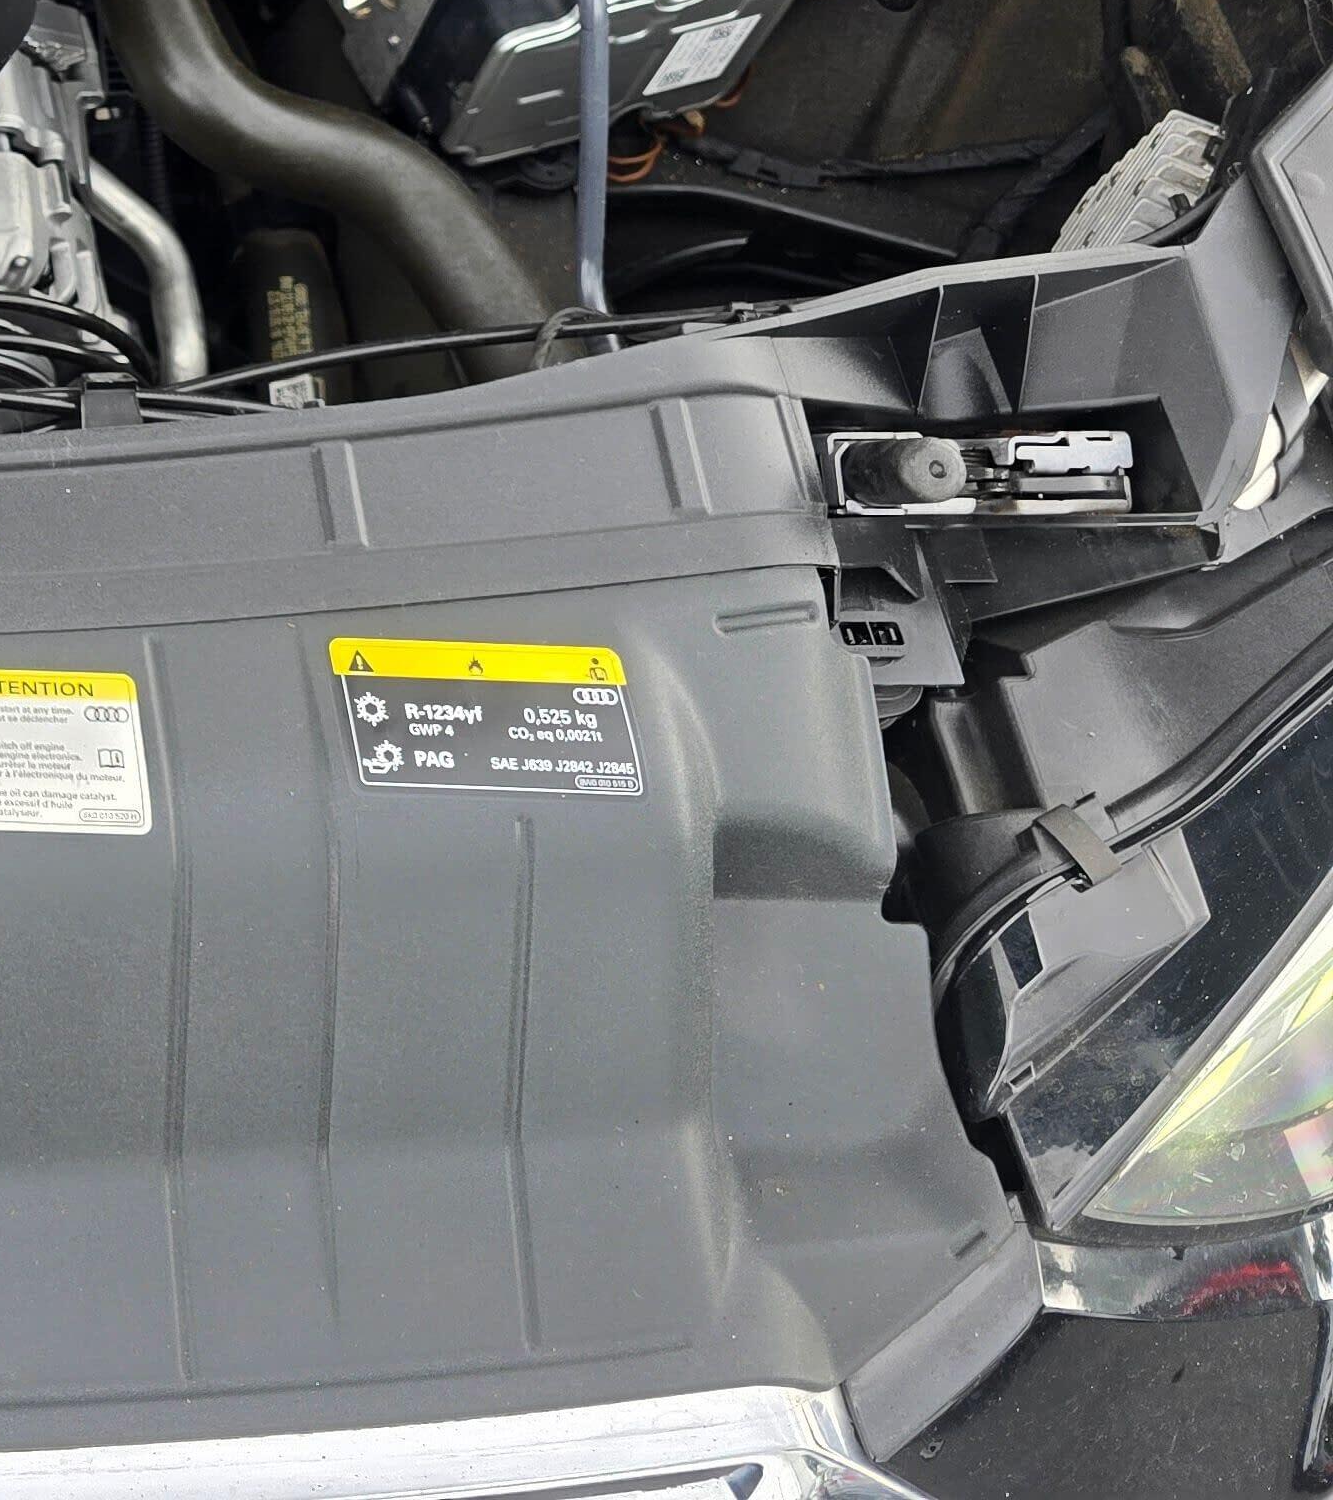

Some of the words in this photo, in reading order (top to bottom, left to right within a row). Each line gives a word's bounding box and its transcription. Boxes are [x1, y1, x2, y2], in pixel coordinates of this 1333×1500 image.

[0, 706, 20, 714] start
[33, 708, 49, 717] any
[405, 703, 483, 725] R-1234yf
[523, 707, 572, 727] 0,525
[575, 709, 598, 729] kg
[409, 723, 442, 737] GWP
[444, 725, 455, 737] 4
[537, 730, 555, 743] eq
[20, 742, 33, 750] off
[34, 743, 65, 752] engine
[0, 752, 30, 761] engine
[414, 750, 455, 769] PAG
[38, 762, 71, 770] moteur
[490, 757, 519, 771] SAE
[521, 758, 553, 772] J639
[555, 760, 594, 774] J2842
[596, 761, 635, 776] J2845
[76, 773, 88, 781] du
[10, 788, 21, 797] oil
[23, 790, 39, 798] can
[41, 790, 78, 800] damage
